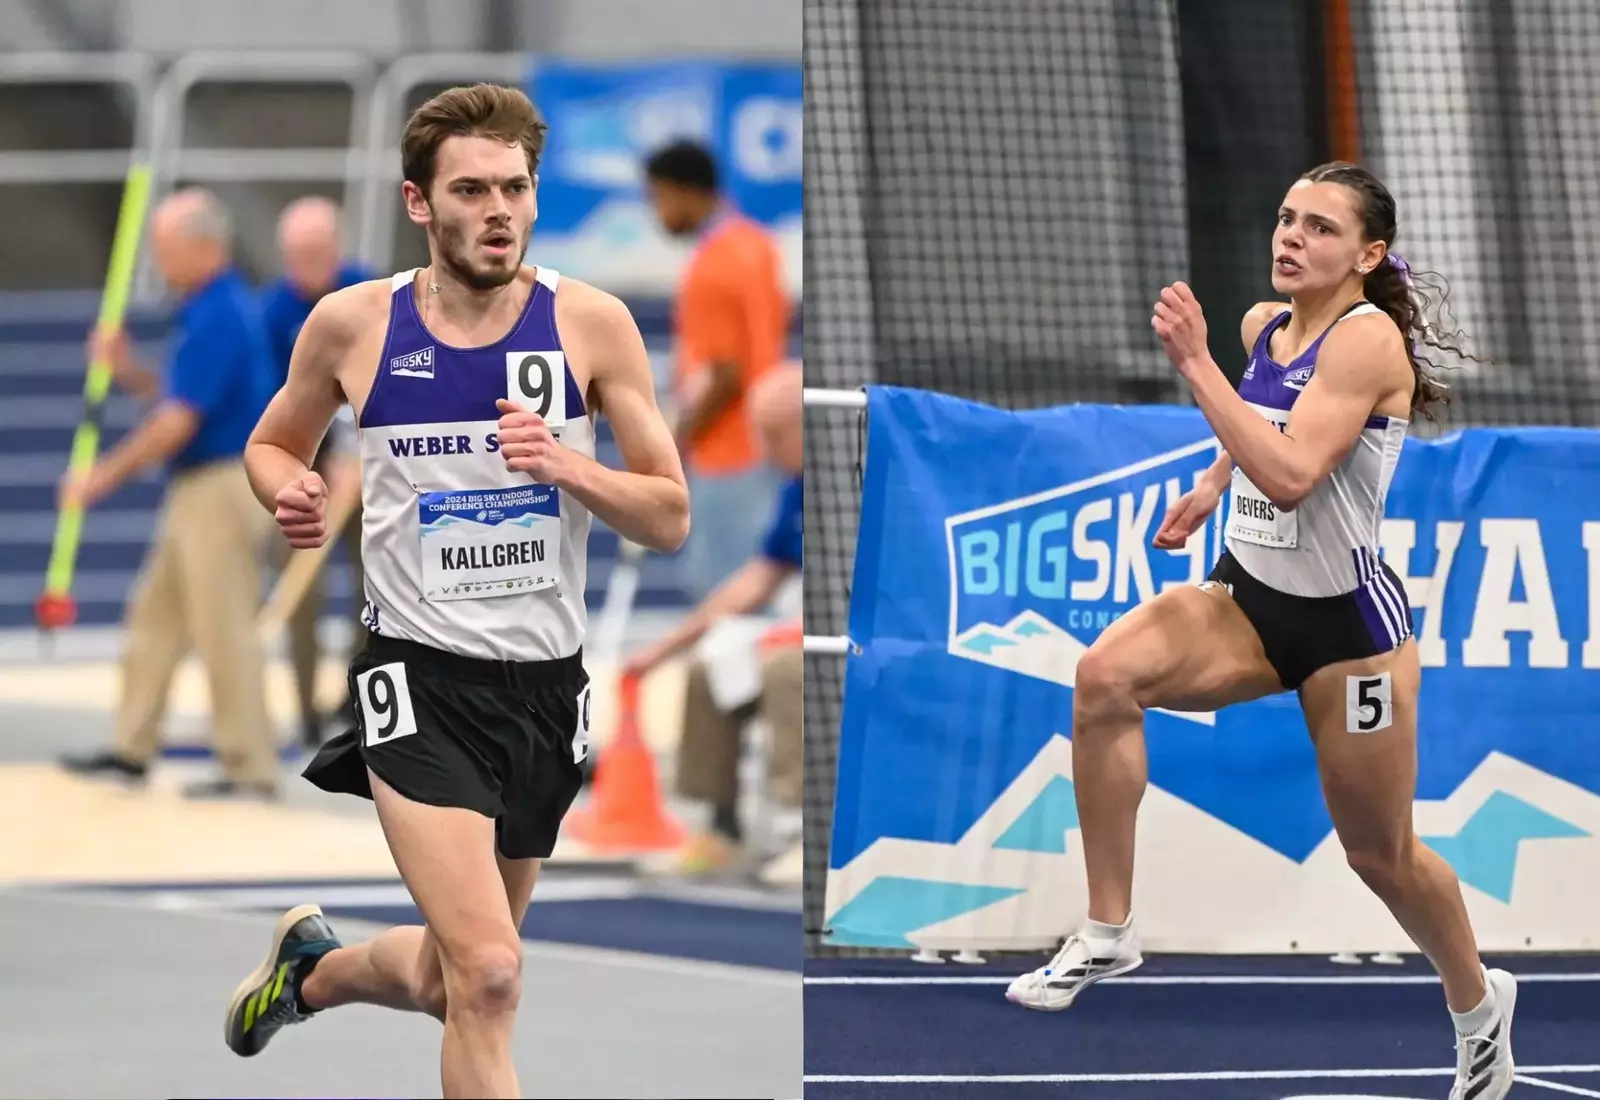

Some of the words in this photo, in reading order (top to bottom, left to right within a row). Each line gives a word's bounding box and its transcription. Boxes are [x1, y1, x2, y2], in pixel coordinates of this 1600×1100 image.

[518, 354, 553, 419] 9
[388, 435, 474, 458] WEBER
[429, 501, 485, 512] CONFERENCE
[485, 495, 549, 509] CHAMPIONSHIP
[445, 496, 467, 504] 2024
[468, 495, 481, 503] BIG
[483, 494, 500, 502] SKY
[501, 490, 534, 500] INDOOR
[1237, 494, 1275, 521] DEVERS
[440, 539, 546, 570] KALLGREN
[367, 670, 399, 739] 9
[1358, 678, 1383, 730] 5
